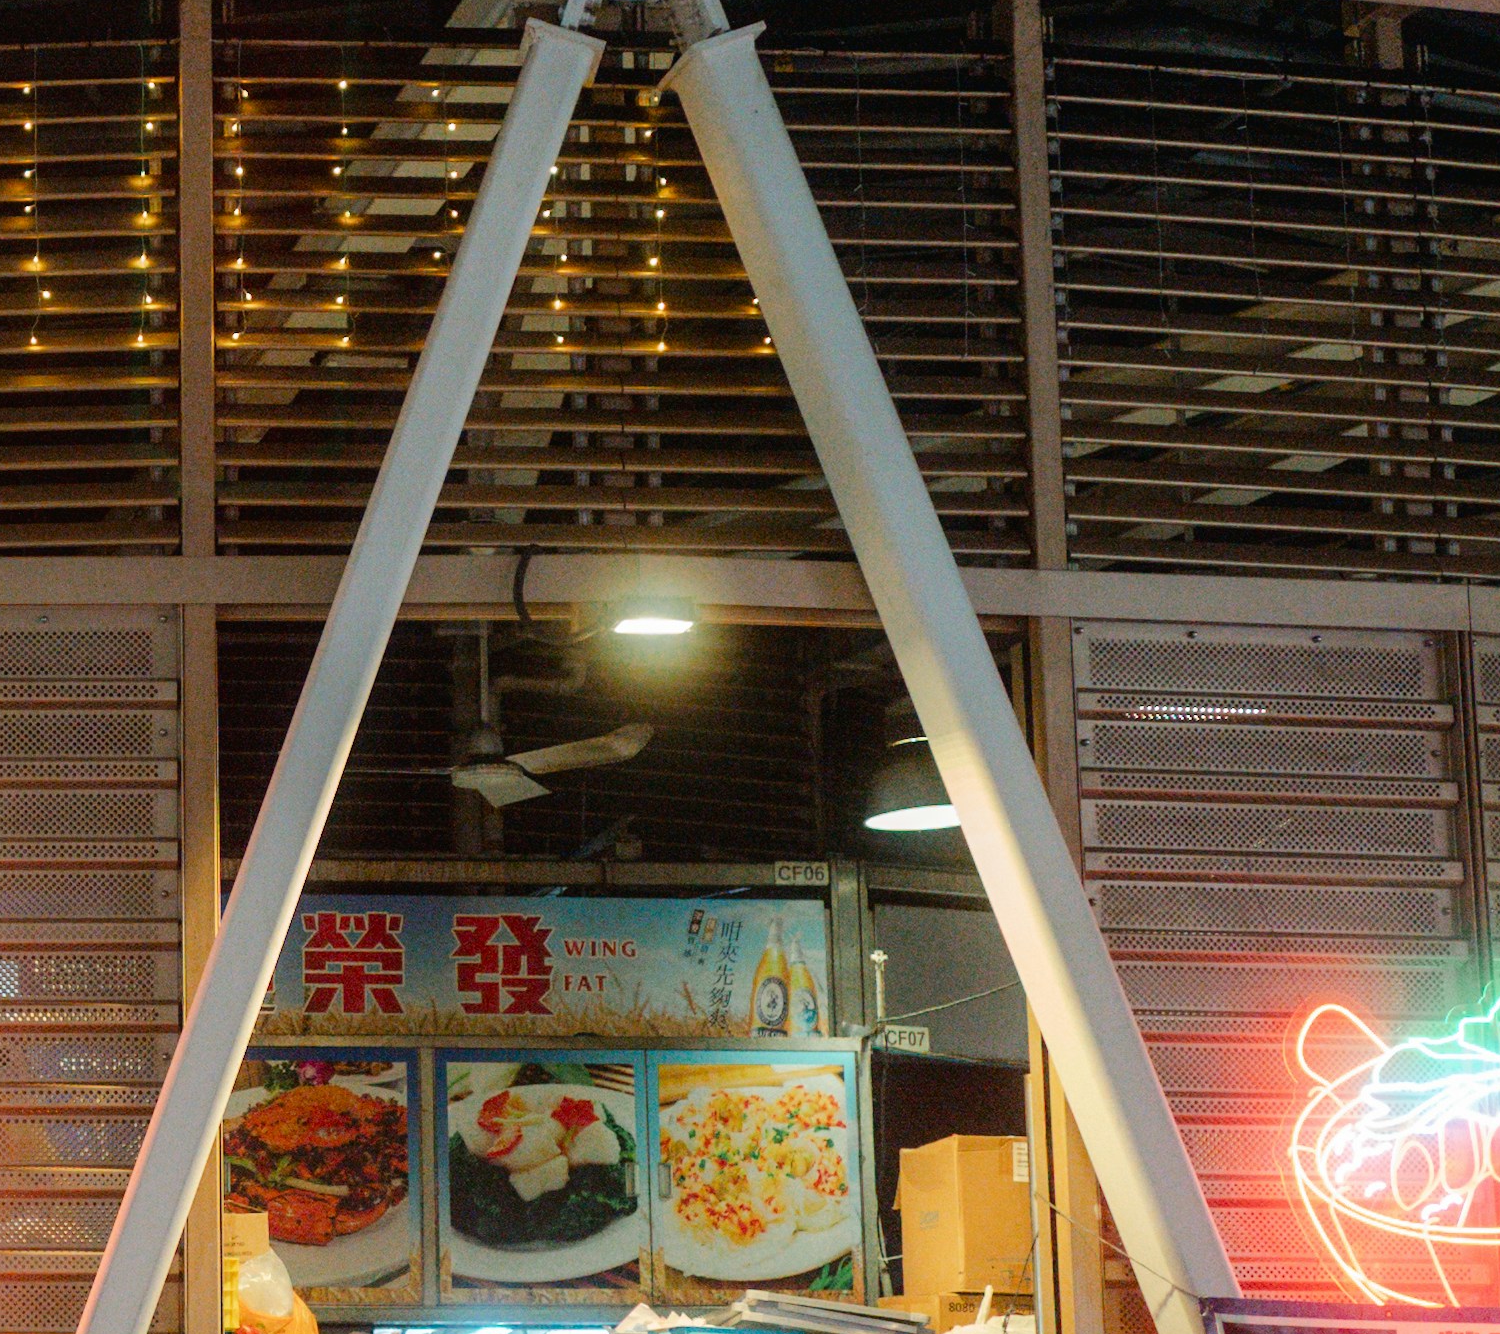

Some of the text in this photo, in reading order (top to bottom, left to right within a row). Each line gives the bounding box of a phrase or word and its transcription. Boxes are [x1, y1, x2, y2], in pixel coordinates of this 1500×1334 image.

[778, 866, 825, 881] CF06
[563, 939, 637, 958] WING
[302, 911, 554, 1015] 榮發
[563, 974, 606, 992] FAT
[887, 1029, 926, 1047] CF07
